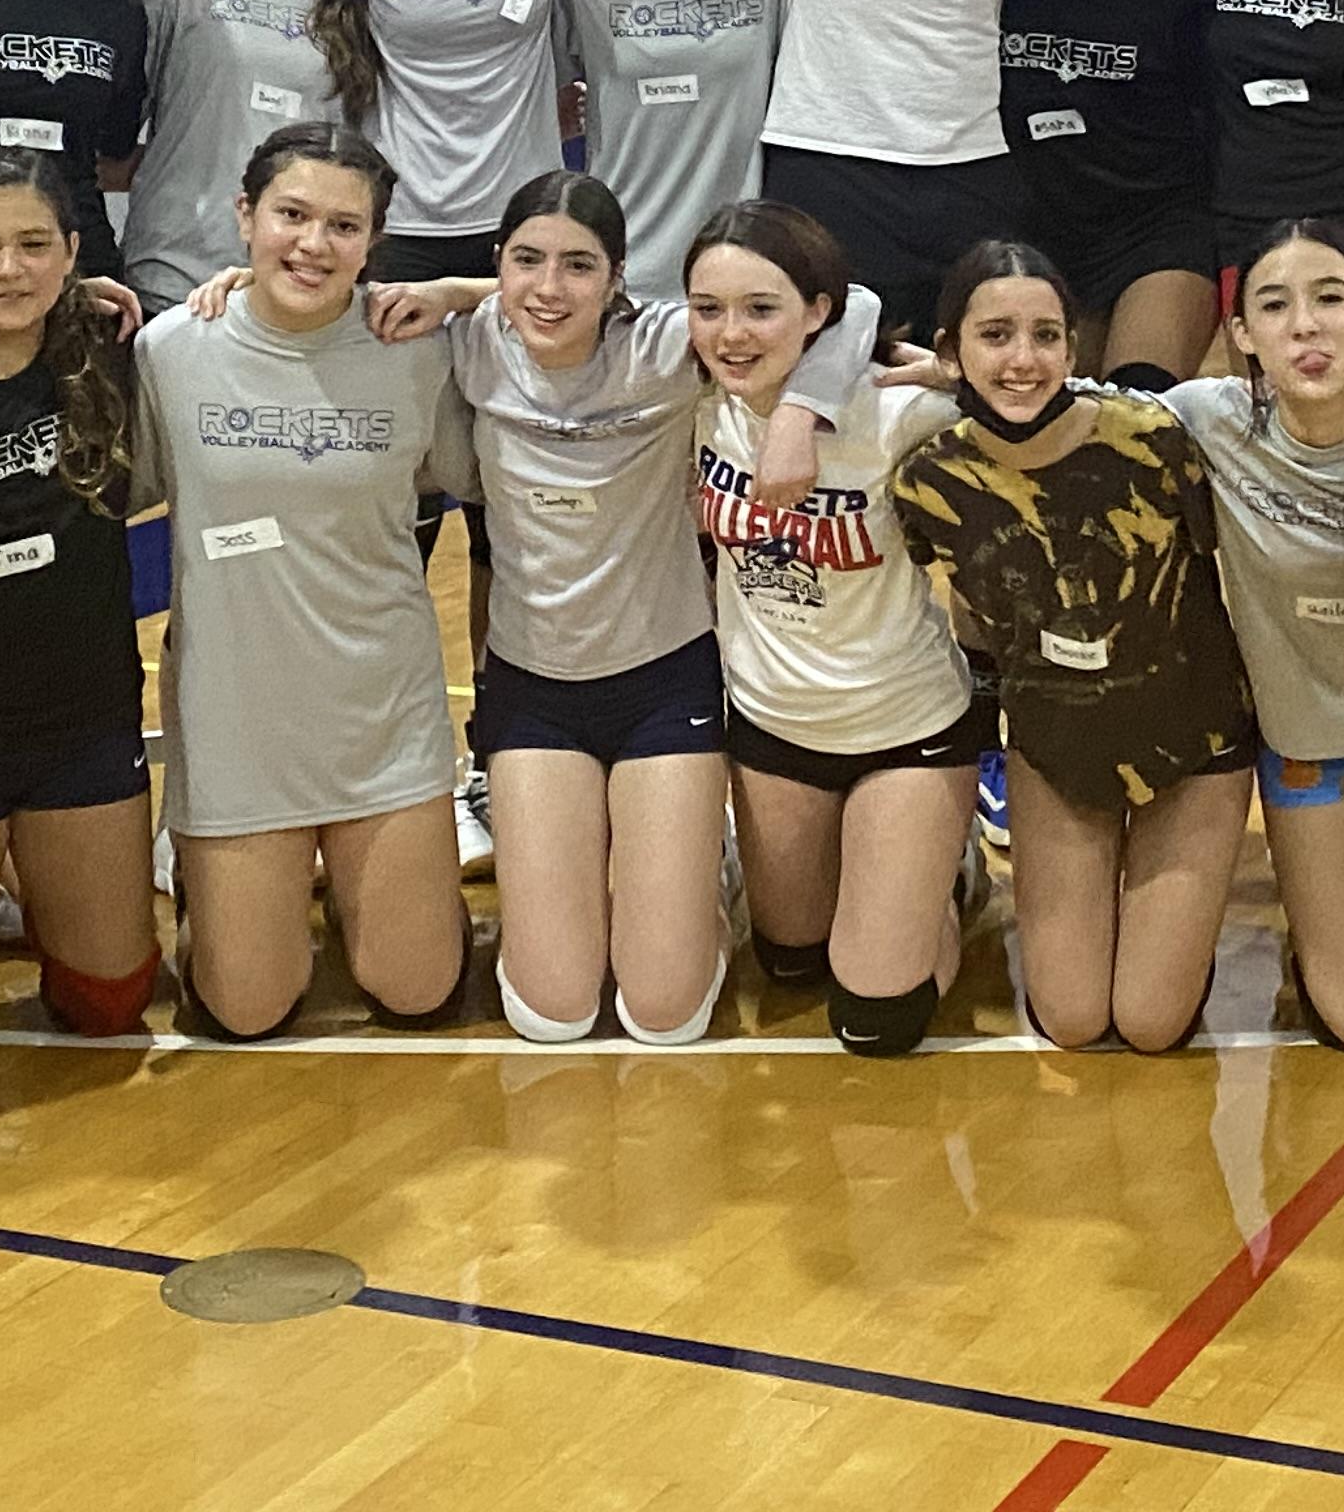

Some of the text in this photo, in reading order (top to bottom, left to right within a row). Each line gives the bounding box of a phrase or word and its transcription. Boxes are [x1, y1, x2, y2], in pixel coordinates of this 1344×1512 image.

[612, 26, 699, 38] VOLLEYBALL
[999, 31, 1138, 72] OCKETS
[198, 402, 395, 439] ROCKETS
[201, 434, 391, 453] VOLLEYBALL ACADEMY
